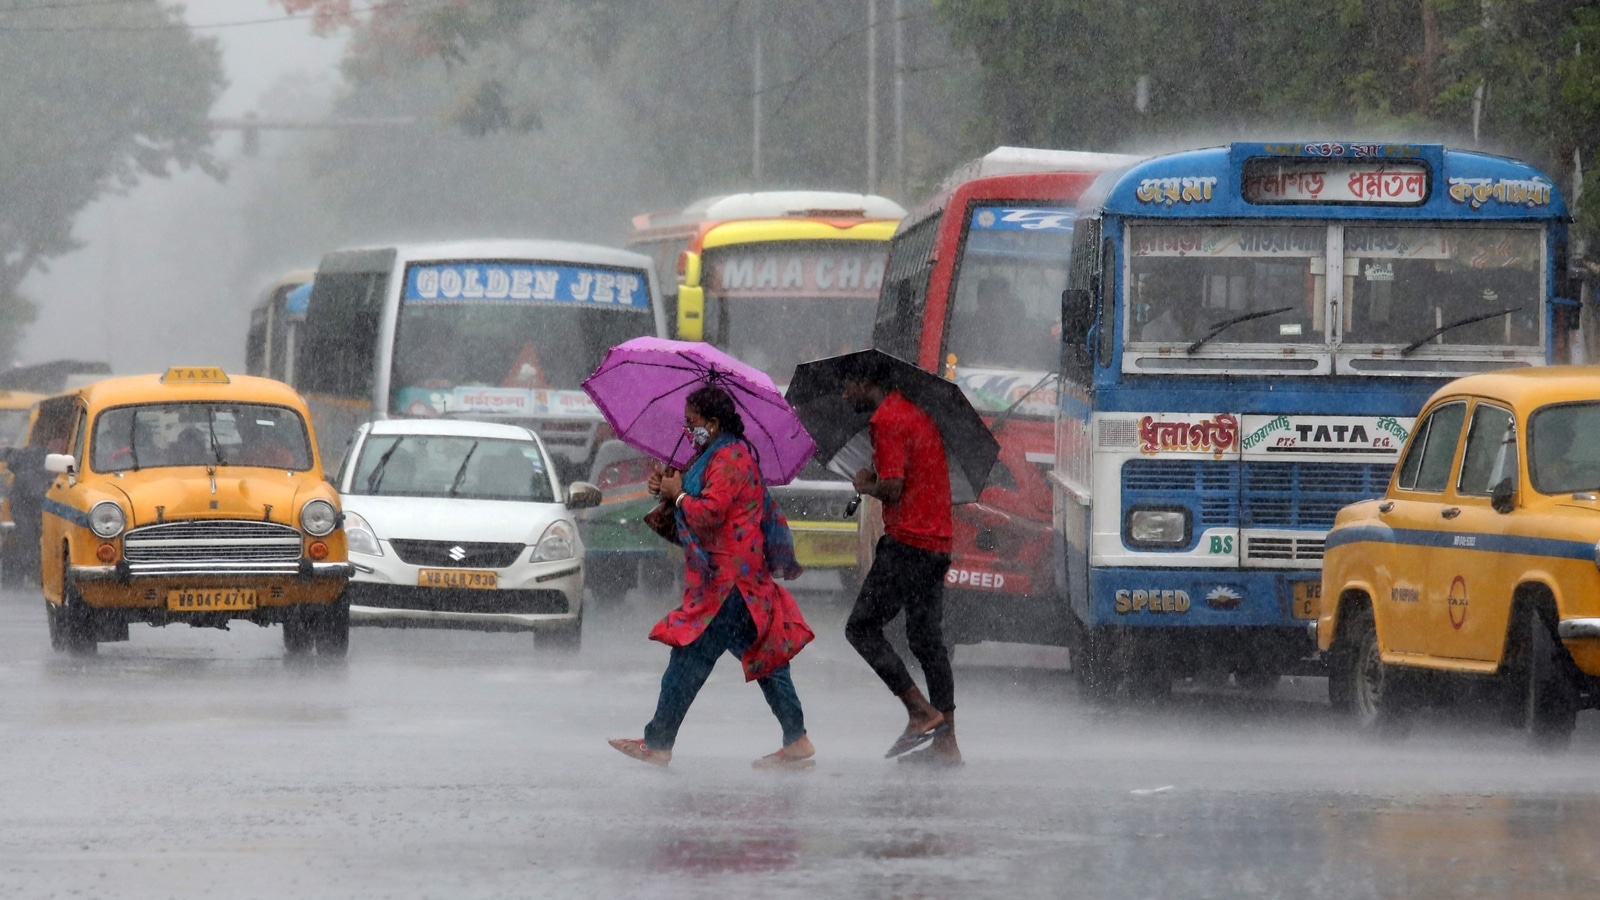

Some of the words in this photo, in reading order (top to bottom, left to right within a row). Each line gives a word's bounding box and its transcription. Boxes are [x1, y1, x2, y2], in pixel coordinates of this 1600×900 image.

[722, 257, 804, 291] MAA
[416, 267, 559, 300] GOLDEN
[570, 272, 639, 305] JET
[173, 369, 219, 379] TAXI
[1296, 424, 1369, 443] TATA
[1208, 535, 1233, 554] BS
[946, 568, 1005, 588] SPEED
[196, 594, 211, 606] 04
[223, 593, 255, 606] 4714
[1115, 588, 1190, 614] SPEED
[1448, 598, 1469, 606] TAXI
